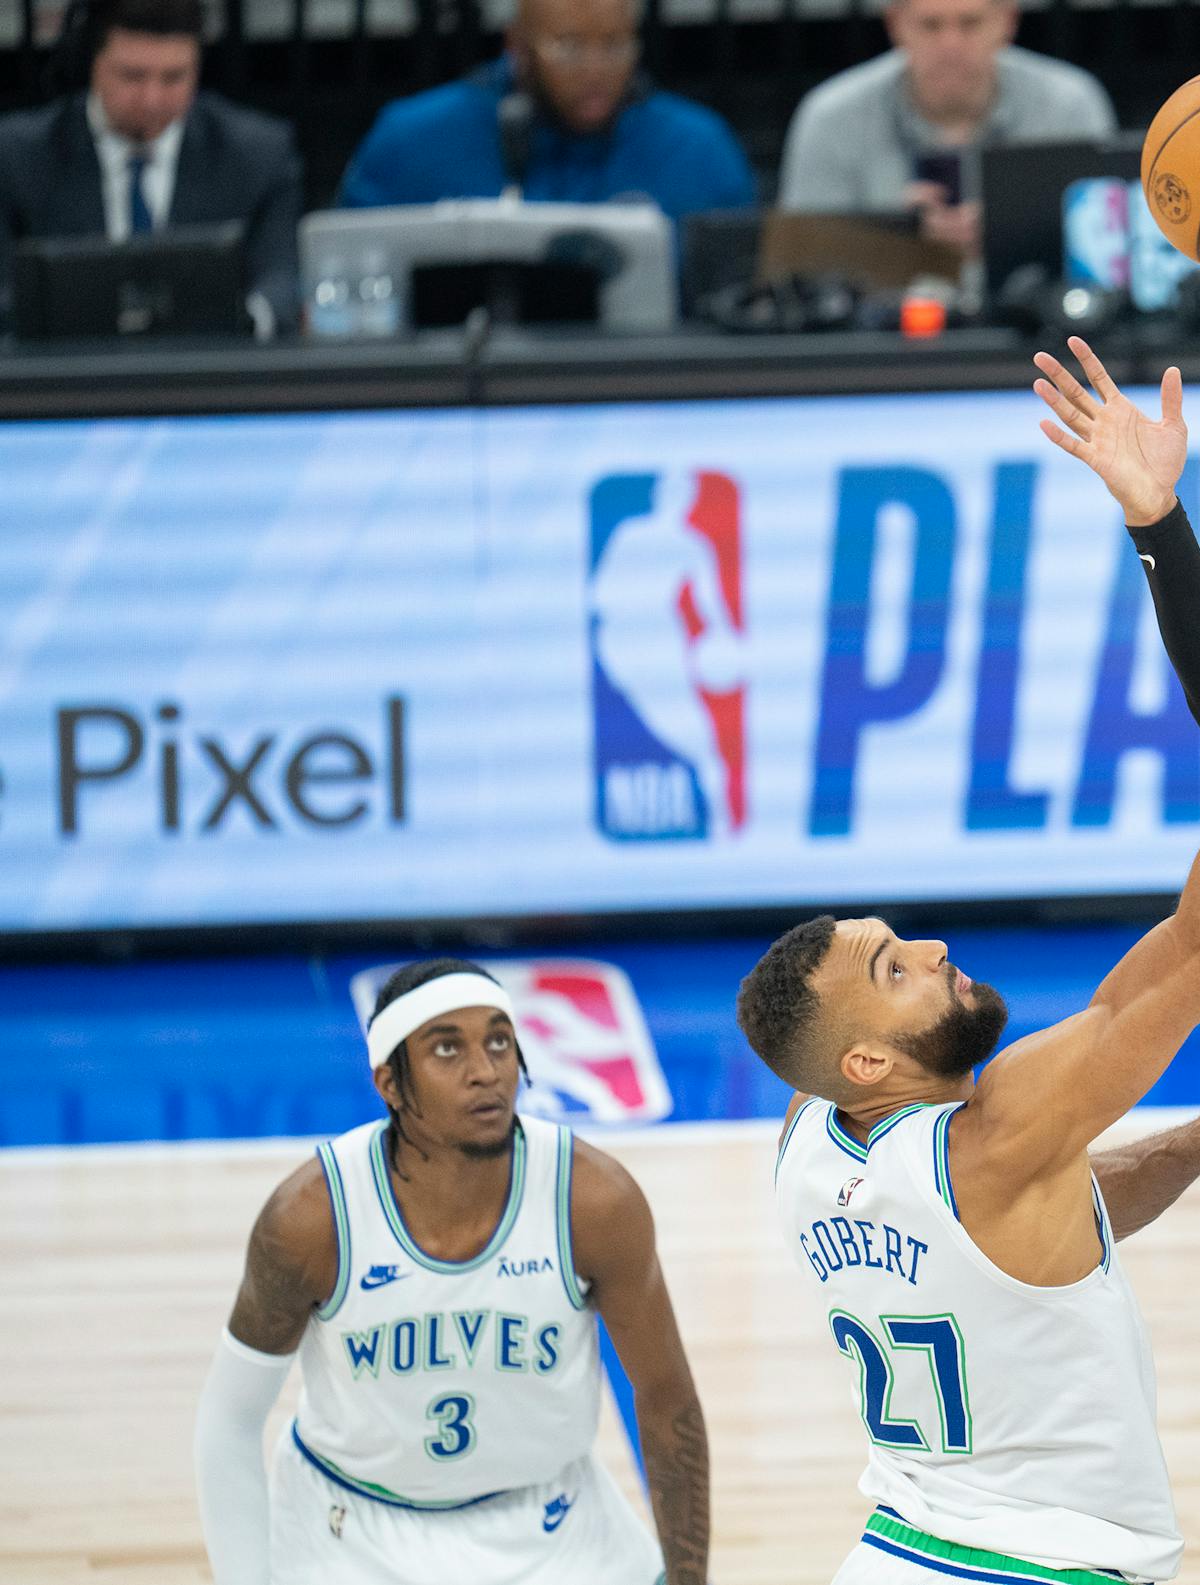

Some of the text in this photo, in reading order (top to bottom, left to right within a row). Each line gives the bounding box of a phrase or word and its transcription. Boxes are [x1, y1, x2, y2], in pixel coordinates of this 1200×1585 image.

[57, 695, 407, 834] Pixel
[800, 1216, 929, 1286] GOBERT
[341, 1309, 563, 1381] WOLVES
[828, 1307, 973, 1455] 27
[424, 1390, 477, 1463] 3
